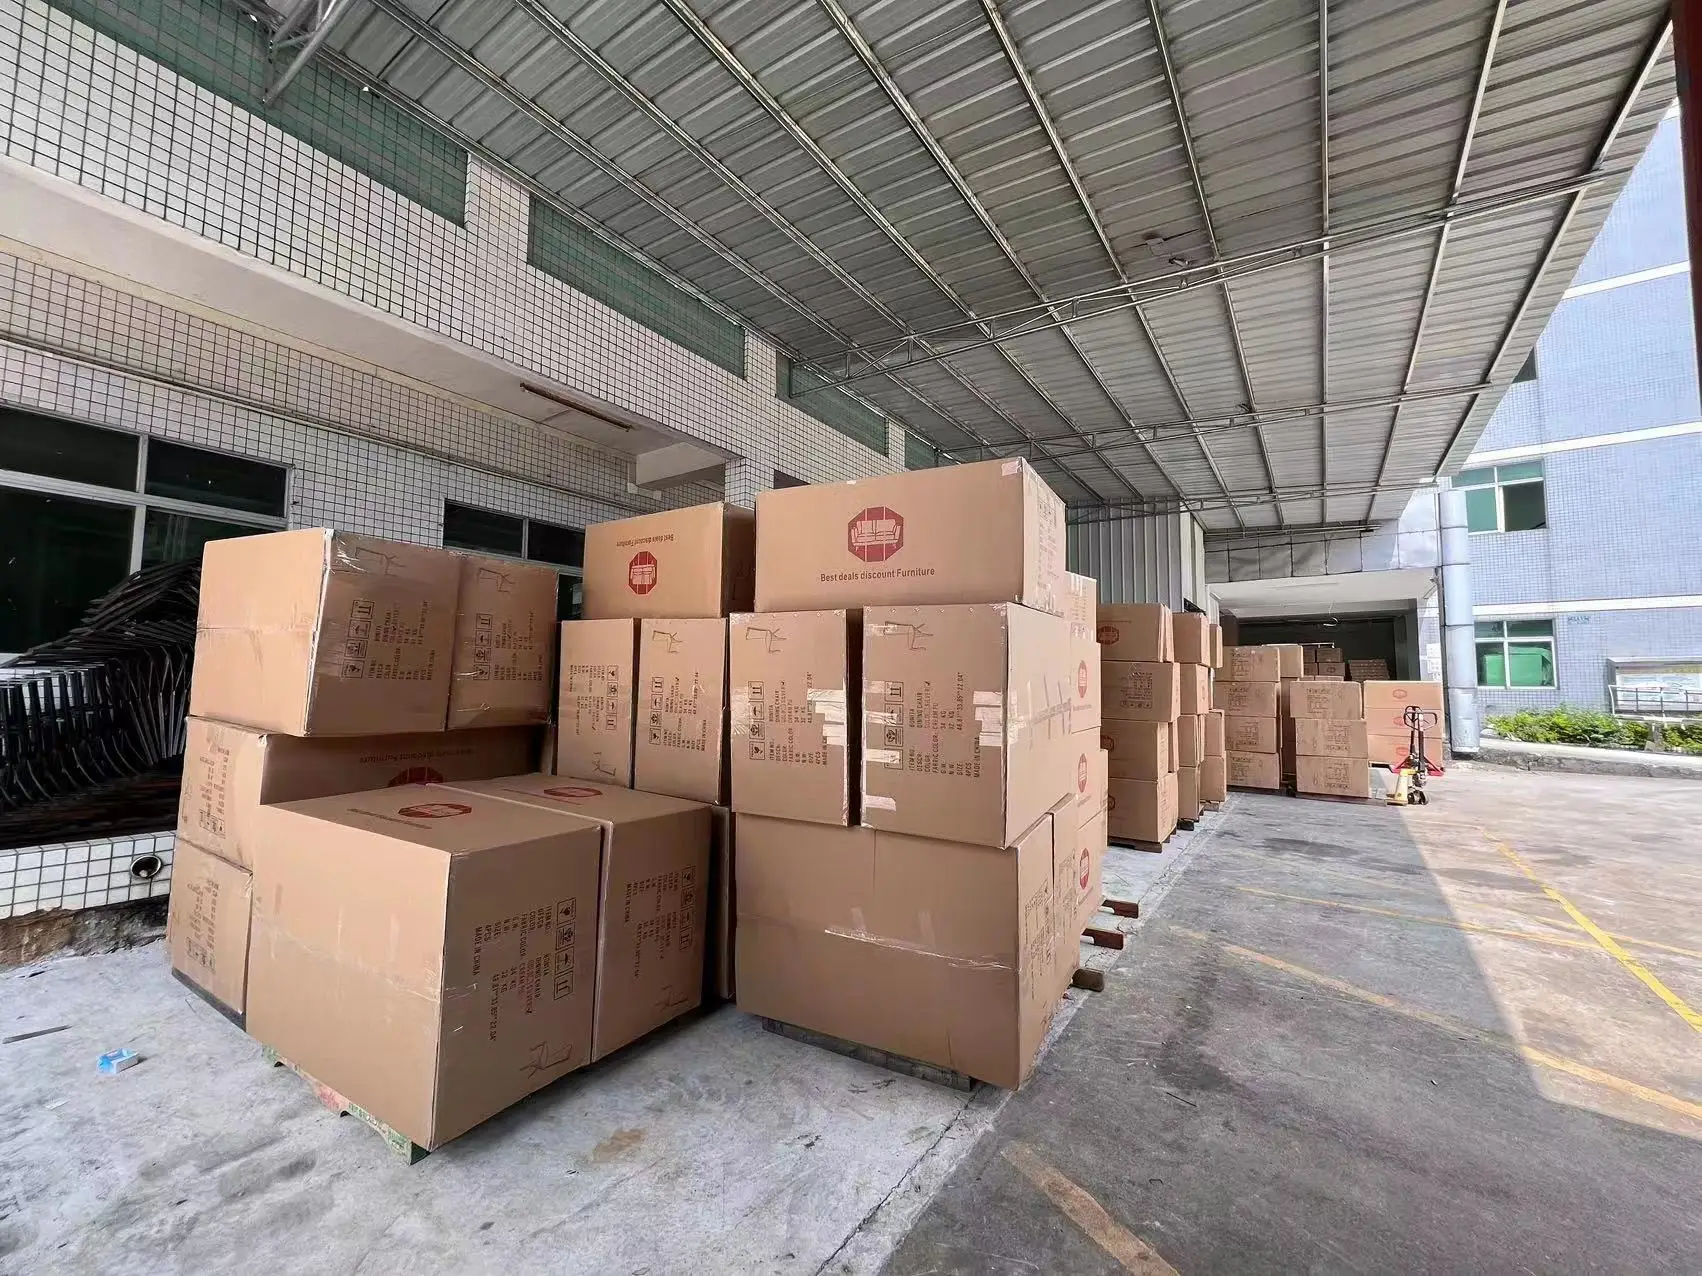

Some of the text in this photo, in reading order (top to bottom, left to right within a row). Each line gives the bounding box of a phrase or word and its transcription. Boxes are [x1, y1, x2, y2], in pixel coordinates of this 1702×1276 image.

[820, 568, 935, 582] Best deals discount Furniture
[474, 927, 482, 944] MADE
[473, 954, 481, 976] CHINA
